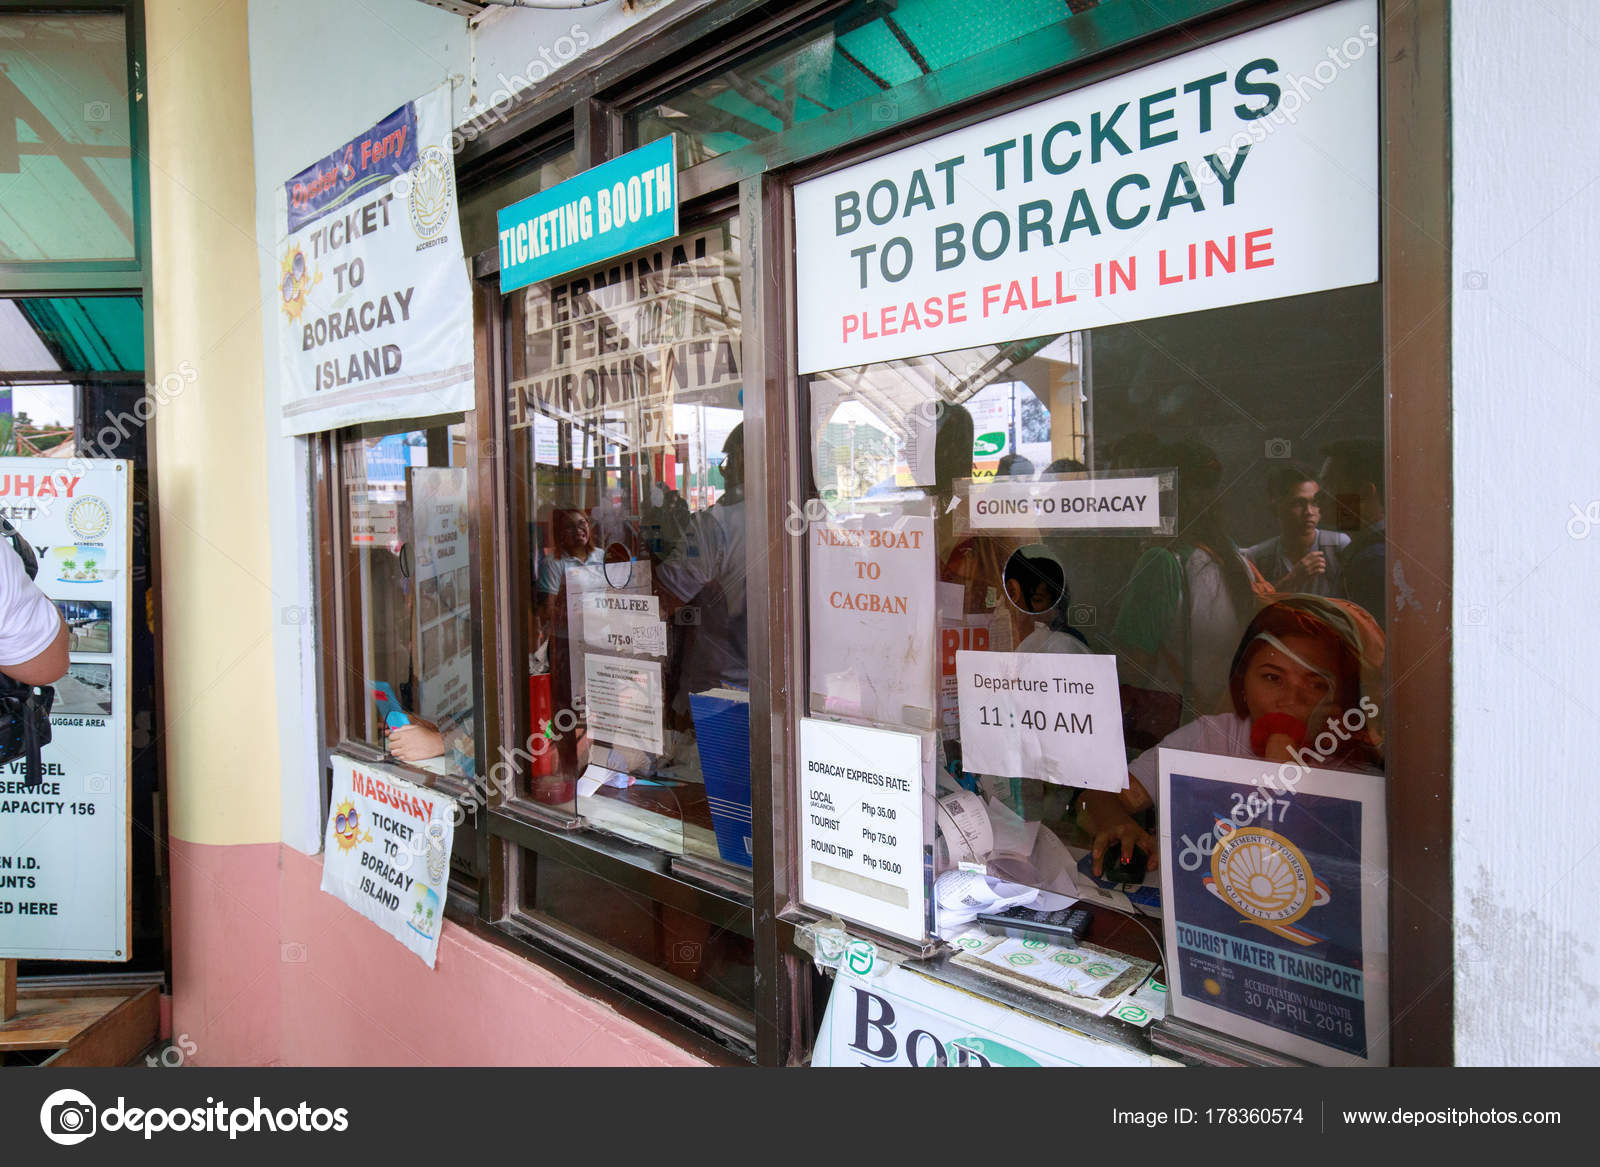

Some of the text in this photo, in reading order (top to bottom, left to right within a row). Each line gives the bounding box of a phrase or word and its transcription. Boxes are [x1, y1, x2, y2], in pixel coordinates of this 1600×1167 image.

[834, 58, 1281, 237] BOAT TICKETS
[293, 125, 407, 211] Oyster Ferry
[310, 192, 393, 259] TICKET
[500, 163, 671, 269] TICKETING BOOTH
[851, 144, 1252, 290] TO BORACAY
[416, 235, 448, 252] ACCREDITED
[333, 256, 365, 294] TO
[842, 228, 1275, 345] PLEASE FALL IN LINE
[302, 287, 415, 352] BORACAY
[315, 344, 402, 392] ISLAND
[508, 334, 742, 425] ENVIRONMENTA
[976, 495, 1147, 516] GOING TO BORACAY
[816, 528, 924, 549] NEXT BOAT
[854, 561, 881, 581] TO
[595, 597, 650, 612] TOTAL FEE
[830, 591, 908, 616] CAGBAN
[608, 633, 633, 646] 175.0
[973, 673, 1095, 695] Departure Time
[50, 718, 106, 728] UGGAGE AREA
[979, 706, 1003, 727] 11
[1021, 709, 1047, 731] 40
[1053, 713, 1094, 735] AM
[10, 762, 66, 776] VESEL
[808, 761, 910, 792] BORACAY EXPRESS RATE:
[0, 781, 61, 795] SERVICE
[352, 769, 434, 825] MABUHAY
[810, 789, 833, 804] LOCAL
[70, 802, 96, 816] 156
[862, 802, 876, 817] Php
[877, 806, 897, 820] 35.00
[1230, 791, 1291, 823] 2017
[372, 811, 414, 842] TICKET
[810, 814, 897, 847] TOURIST Php 75.00
[17, 856, 40, 870] I.D.
[384, 839, 399, 859] TO
[811, 839, 902, 875] ROUND TRIP Php 150.00
[1220, 835, 1262, 864] DEPARTMENT
[1278, 844, 1305, 881] TOURISM
[361, 851, 414, 892] BORACAY
[18, 902, 58, 916] HERE
[359, 876, 400, 912] ISLAND
[1226, 884, 1302, 919] QUALITY SEAL
[1177, 926, 1361, 994] TOURIST WATER TRANSPORT
[1244, 978, 1353, 1021] ACCREDITATION VALID UNTIL
[1244, 991, 1354, 1038] 30 APRIL 2018
